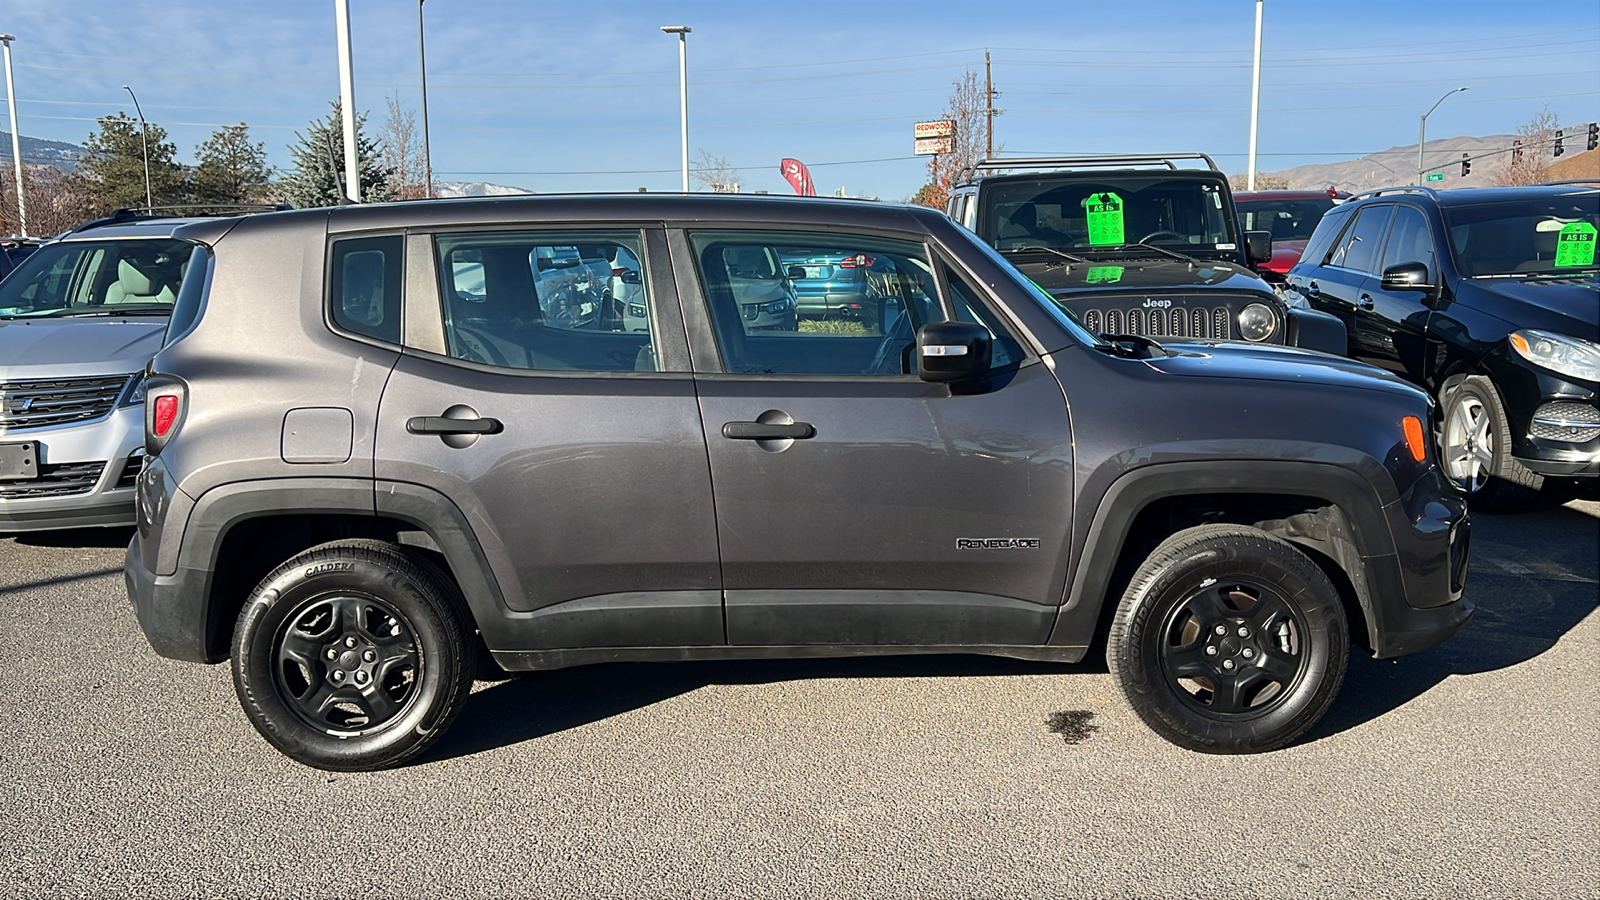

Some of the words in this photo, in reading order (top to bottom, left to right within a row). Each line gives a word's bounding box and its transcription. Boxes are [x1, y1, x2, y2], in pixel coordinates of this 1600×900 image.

[916, 122, 950, 131] REDWOOD
[1142, 298, 1172, 309] Jeep
[956, 537, 1040, 550] RENEGADE
[304, 561, 356, 578] CALDERA
